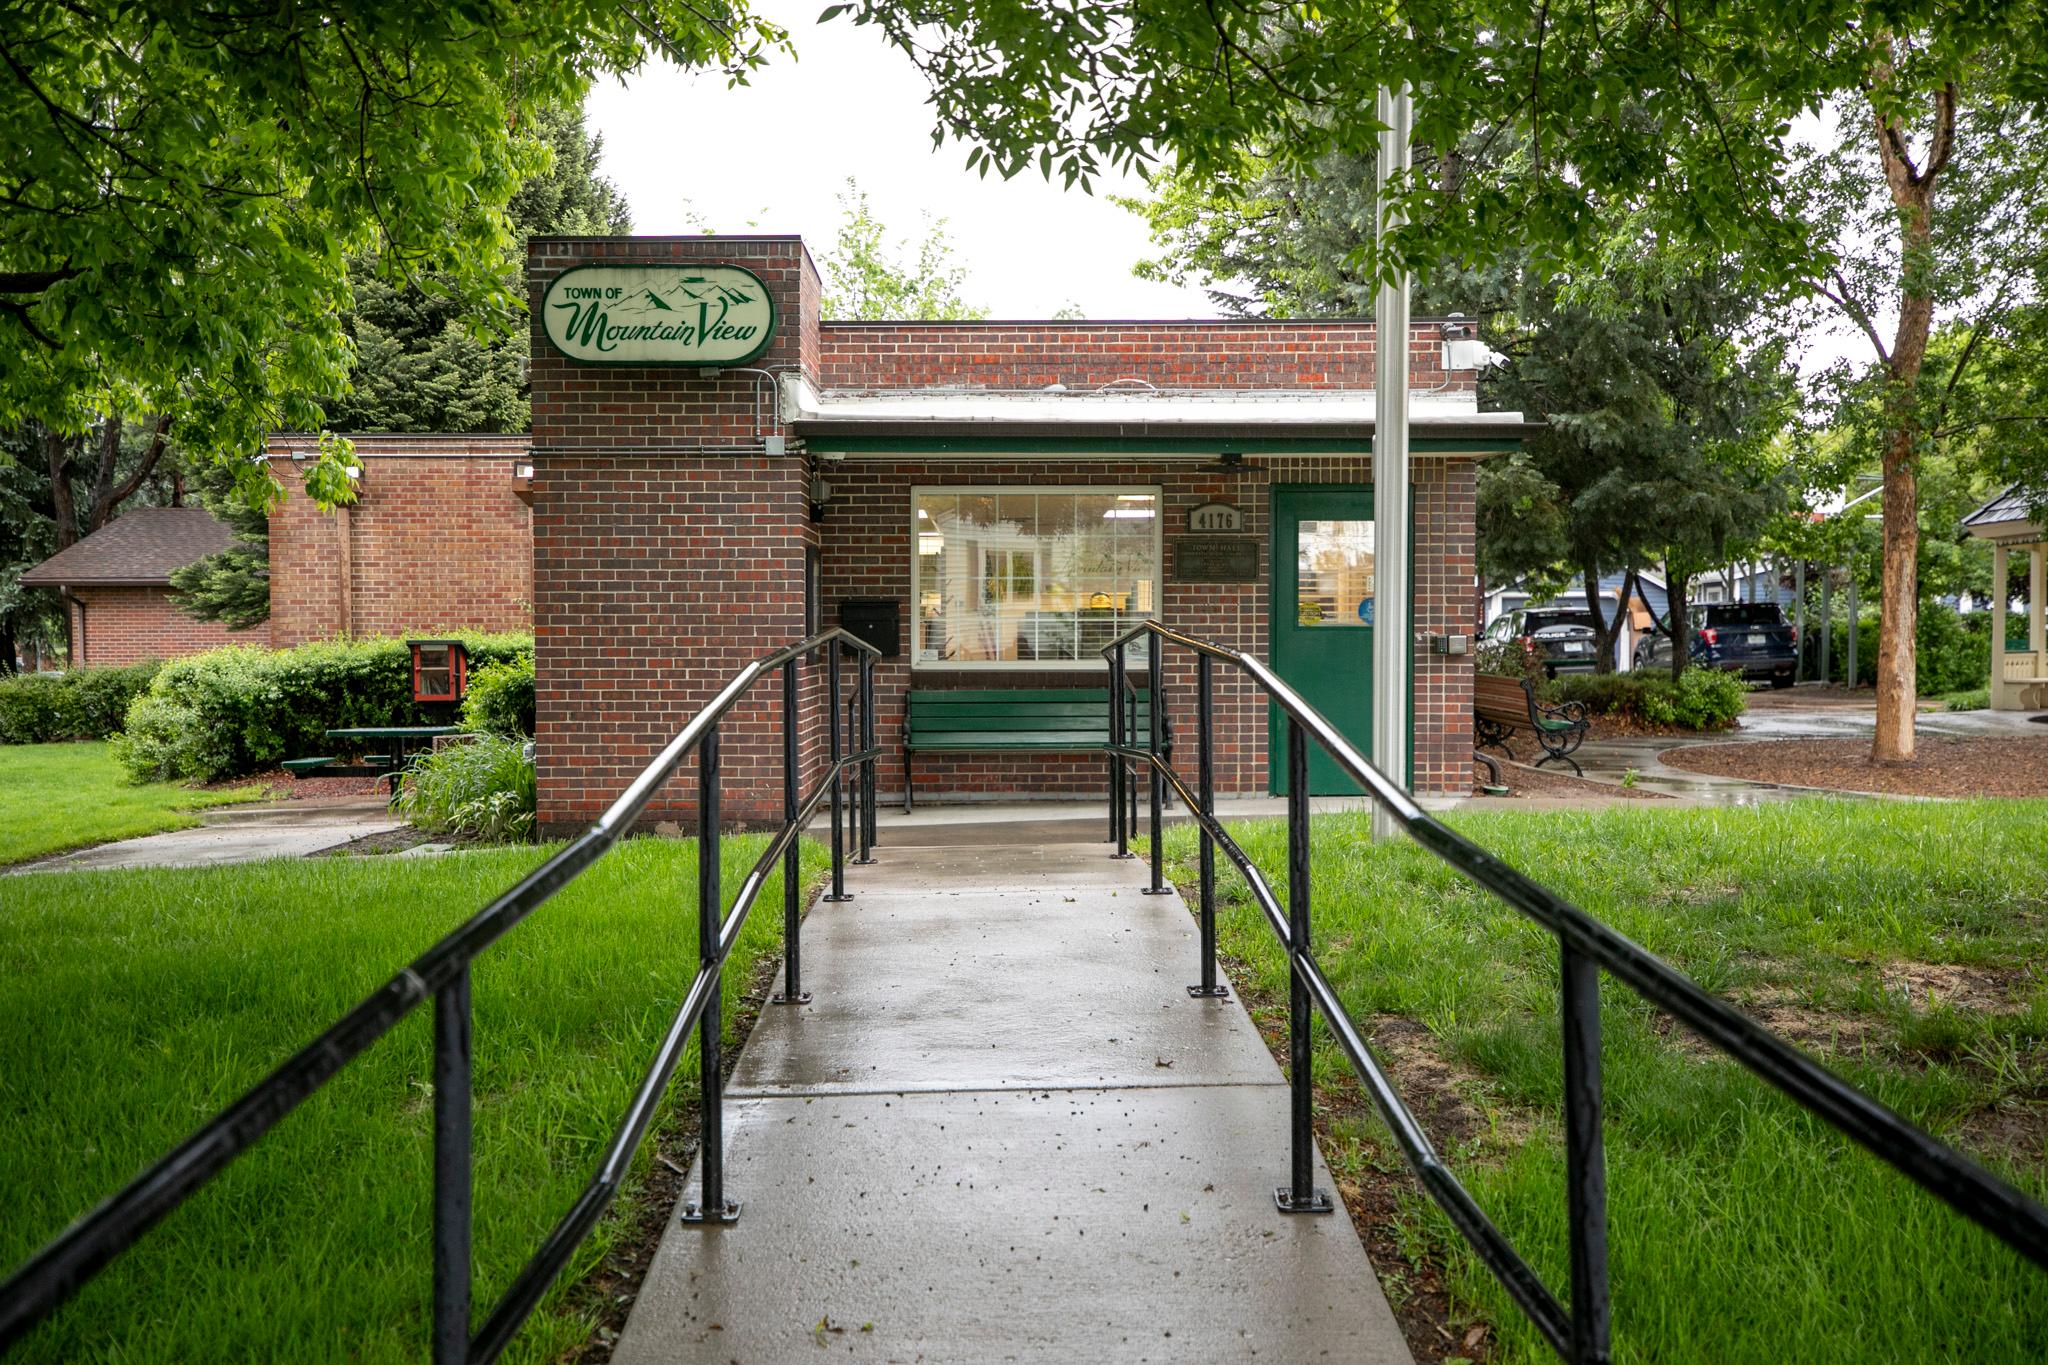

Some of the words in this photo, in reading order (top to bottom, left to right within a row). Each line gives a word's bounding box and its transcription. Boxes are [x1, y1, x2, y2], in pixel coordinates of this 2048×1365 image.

[564, 287, 601, 299] TOWN
[605, 287, 623, 299] OF
[551, 301, 696, 352] Mountain
[697, 296, 758, 349] View
[1198, 512, 1233, 529] 4176
